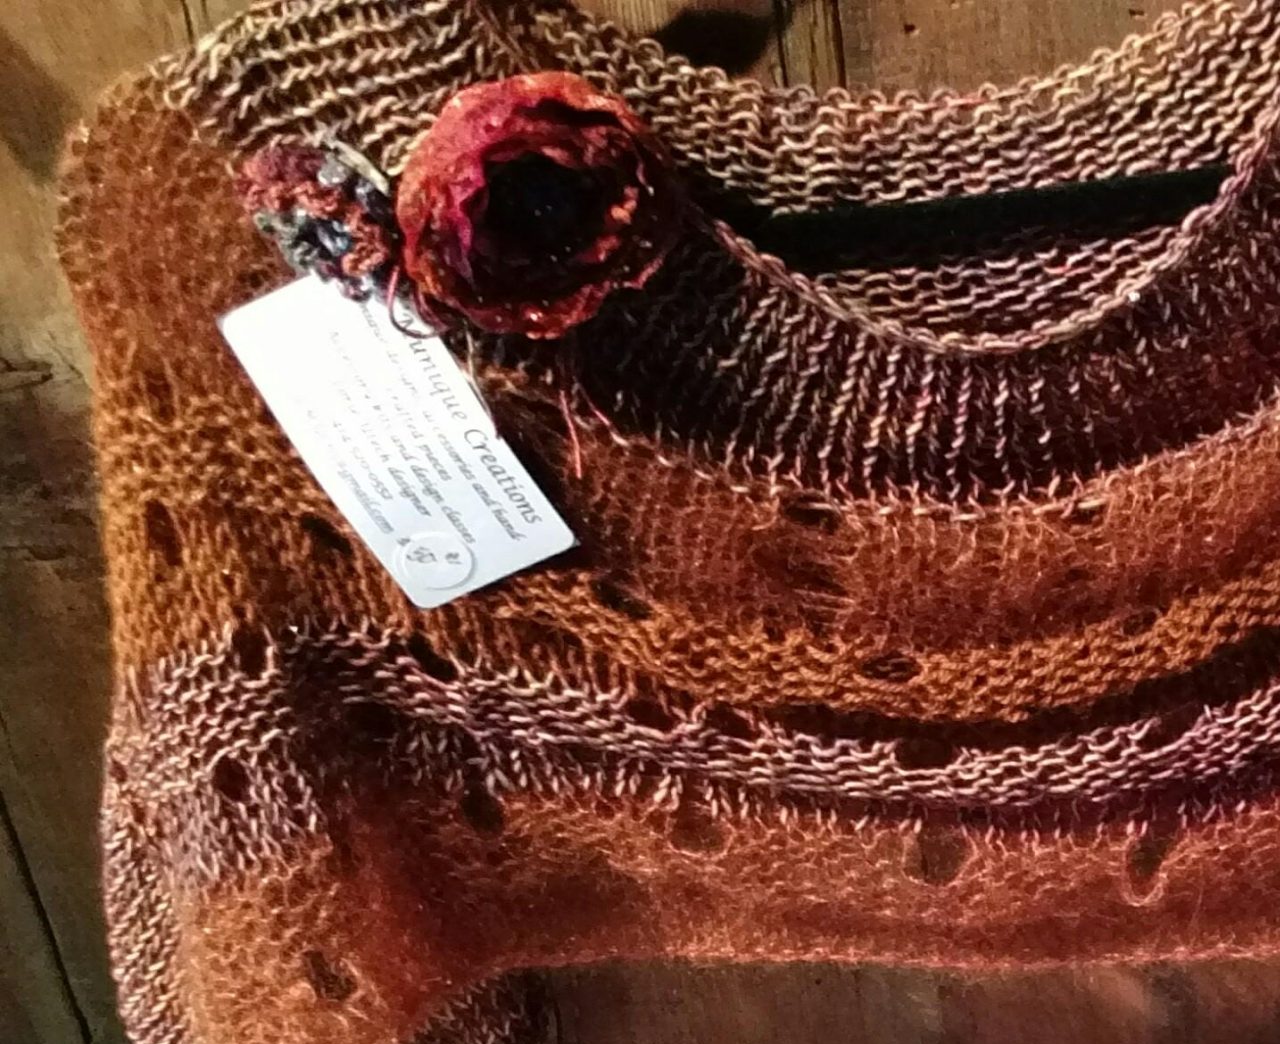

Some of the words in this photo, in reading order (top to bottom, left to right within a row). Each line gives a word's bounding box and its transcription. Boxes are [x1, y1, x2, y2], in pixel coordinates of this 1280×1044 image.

[417, 443, 452, 481] pieces
[463, 428, 542, 524] Creations
[386, 466, 432, 517] designer
[409, 464, 444, 504] design
[440, 504, 476, 547] classes
[470, 482, 501, 507] and
